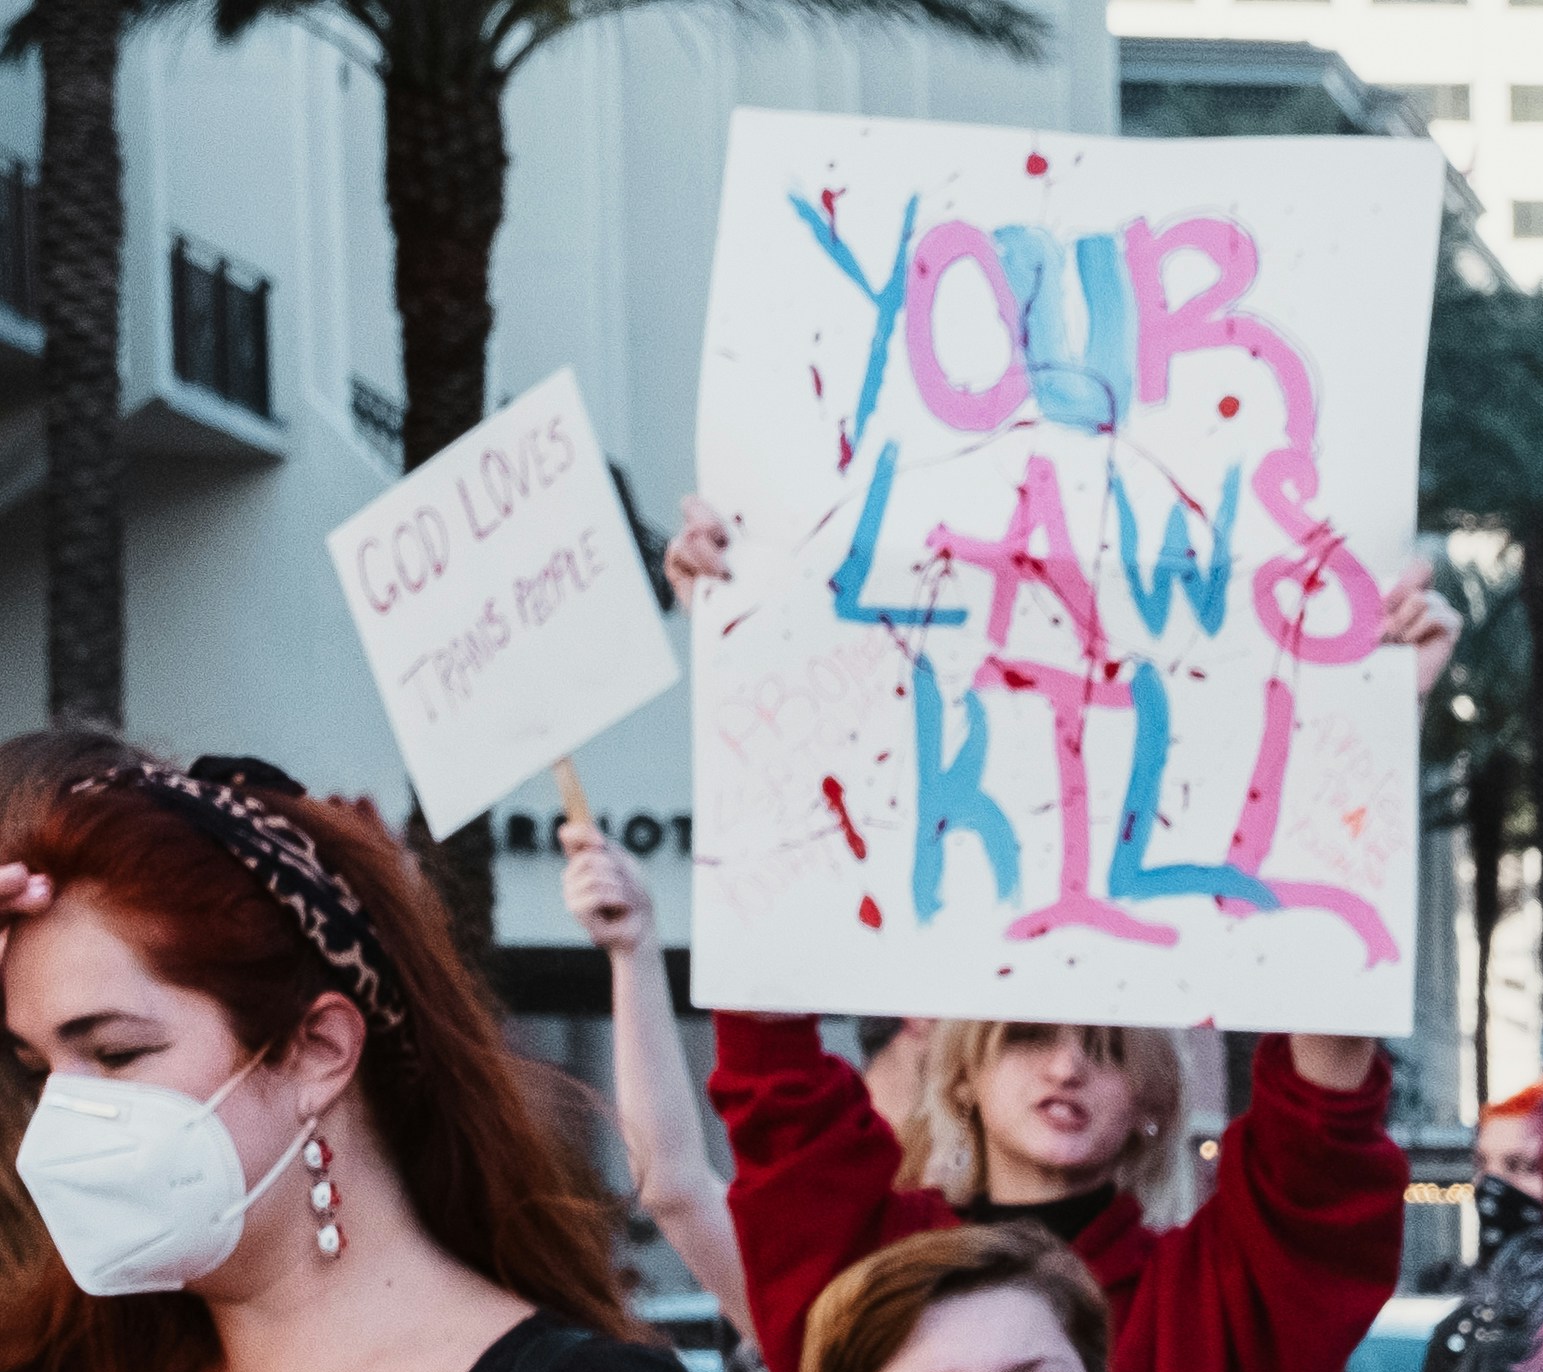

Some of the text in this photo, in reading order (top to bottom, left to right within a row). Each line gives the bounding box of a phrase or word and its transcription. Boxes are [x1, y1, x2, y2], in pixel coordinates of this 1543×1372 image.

[788, 190, 1317, 453] YOUR
[357, 414, 577, 616] GOD LOVES
[834, 440, 1385, 665] LAWS
[400, 596, 511, 722] TRANS
[910, 650, 1399, 969] KILL
